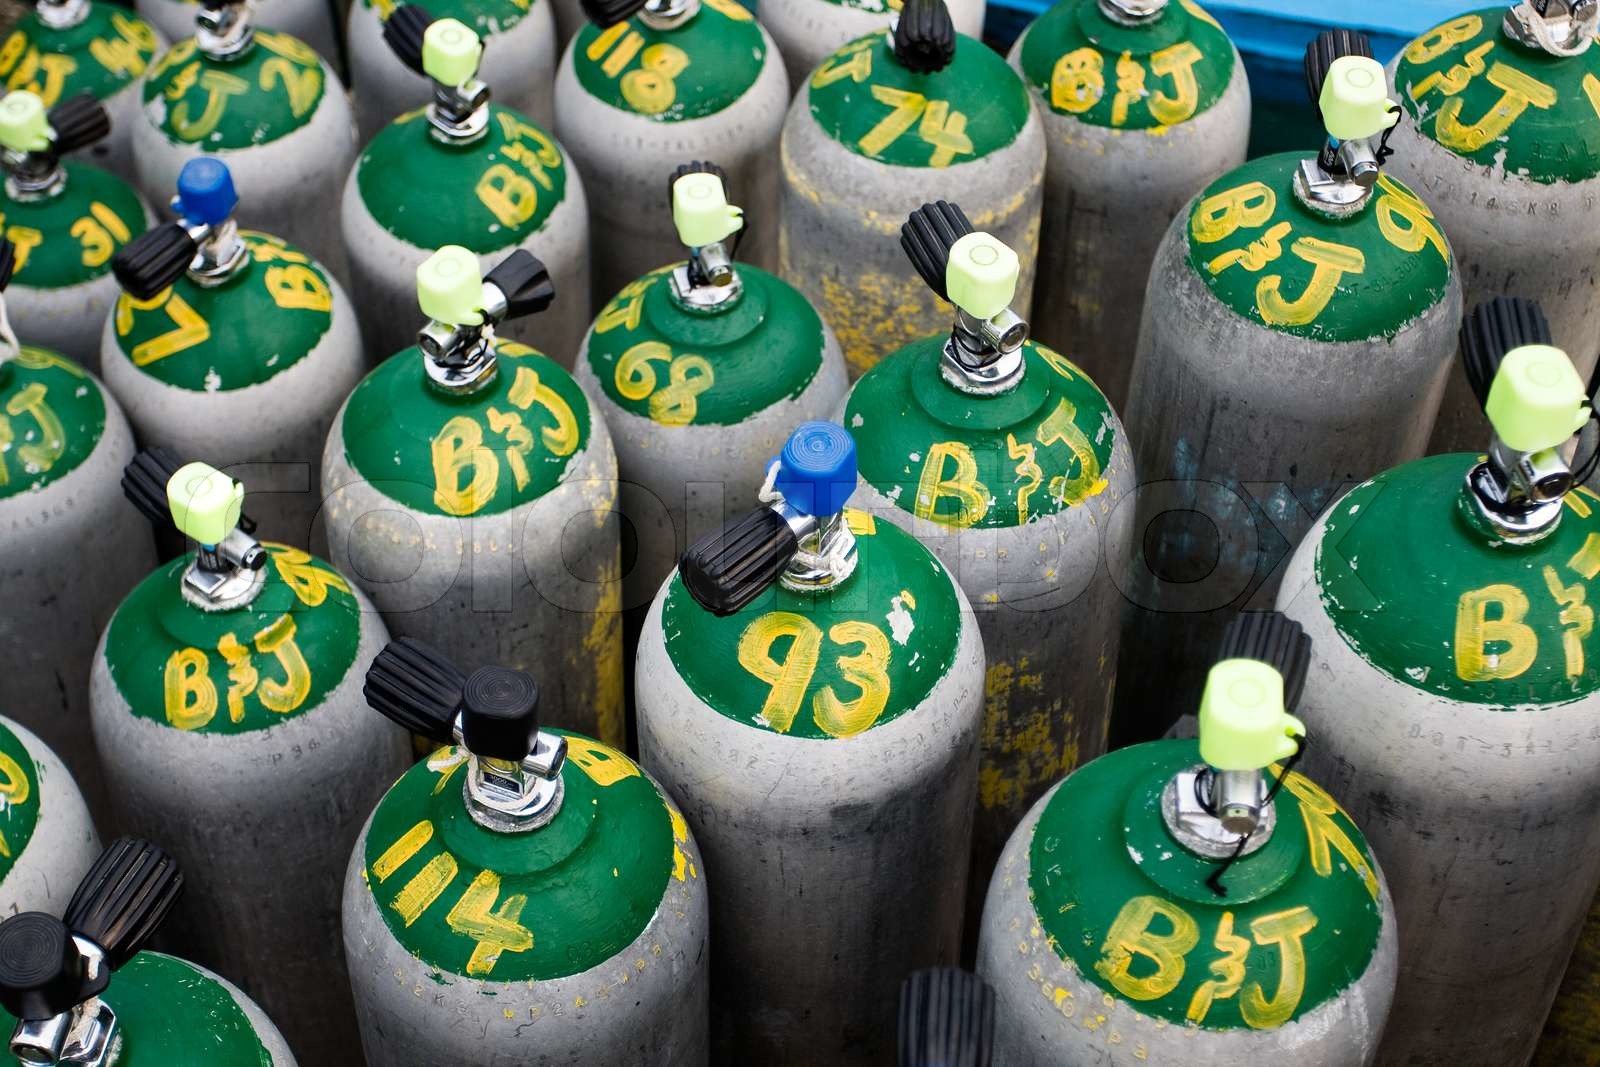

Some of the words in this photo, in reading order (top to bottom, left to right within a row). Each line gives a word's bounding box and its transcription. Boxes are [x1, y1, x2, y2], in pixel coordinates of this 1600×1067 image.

[858, 84, 975, 170] 74
[1050, 41, 1204, 127] B&J
[1405, 14, 1558, 152] B&J
[70, 201, 131, 268] 31
[1191, 181, 1366, 326] B&J
[431, 366, 580, 516] B&J
[614, 340, 715, 428] 68
[914, 396, 1110, 531] B&J
[164, 612, 312, 731] B&J
[737, 610, 892, 739] 93
[372, 819, 535, 976] 114
[1093, 894, 1319, 1031] B&J
